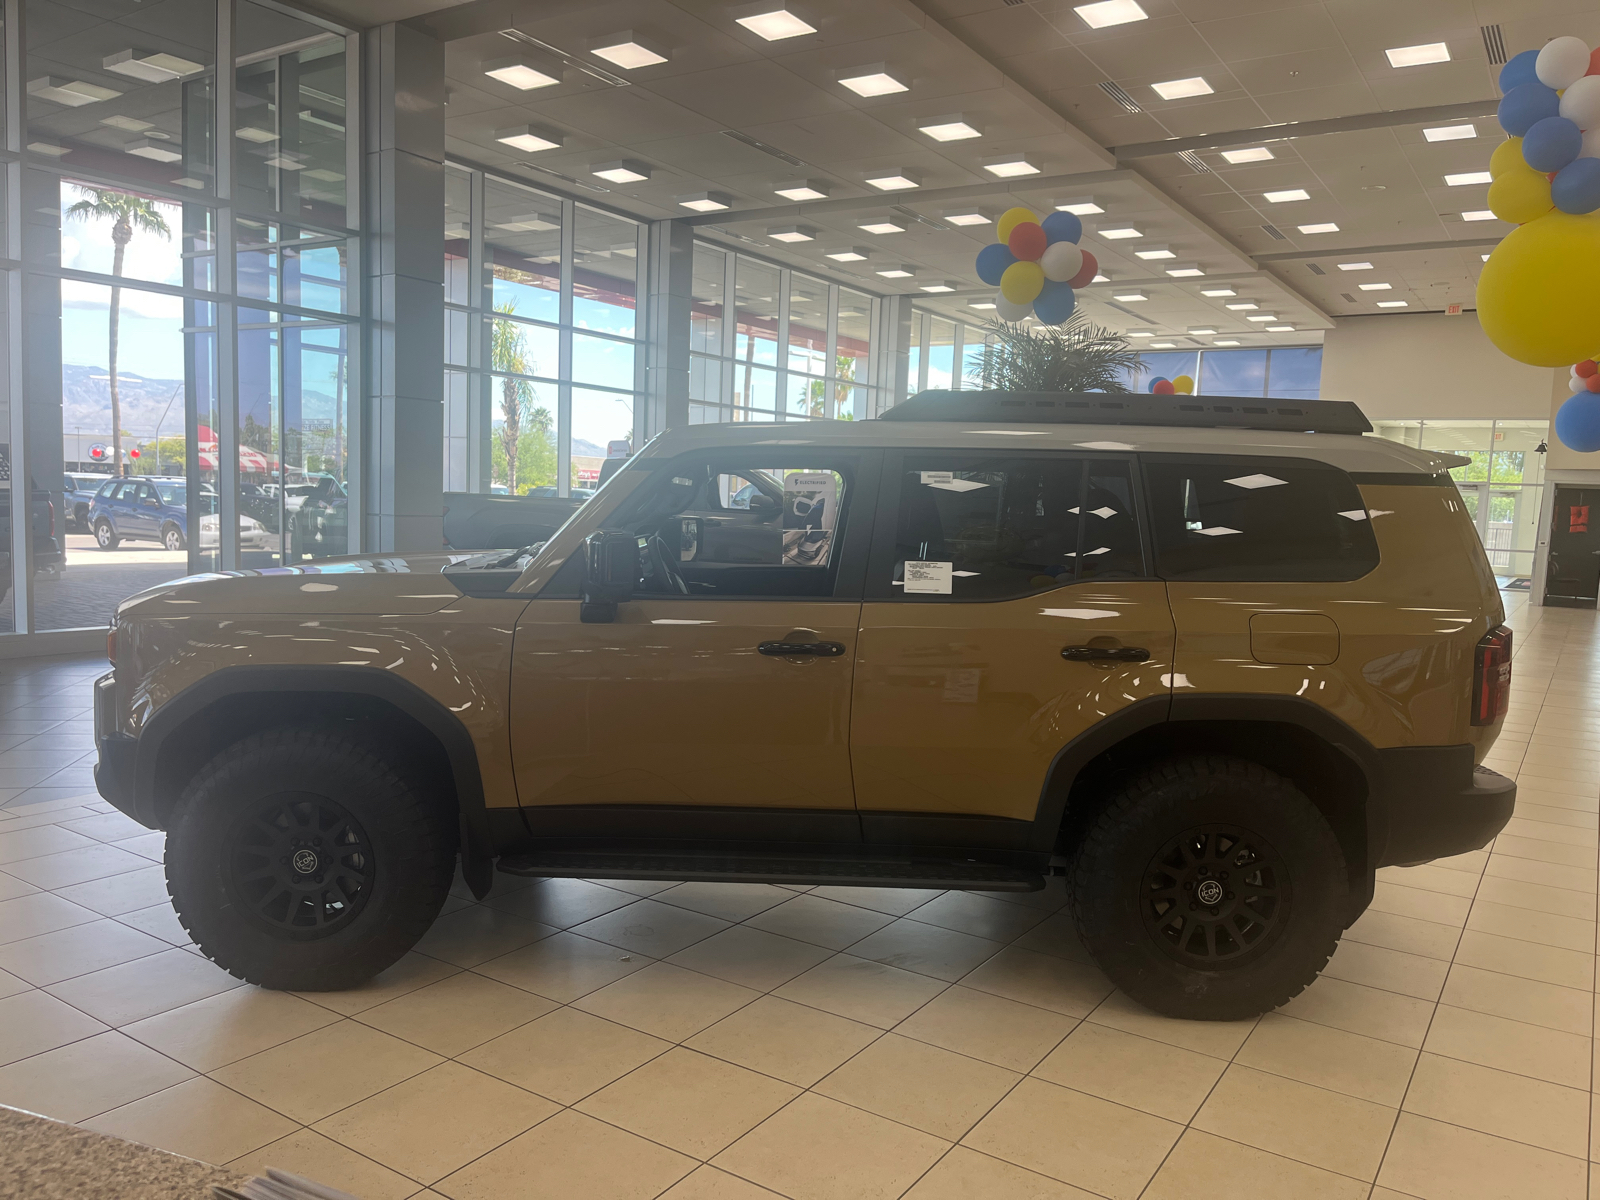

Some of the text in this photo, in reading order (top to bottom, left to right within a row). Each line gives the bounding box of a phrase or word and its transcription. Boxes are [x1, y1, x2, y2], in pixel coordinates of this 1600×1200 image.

[1448, 305, 1460, 314] EXIT
[296, 854, 314, 868] ICON
[1201, 887, 1219, 898] ICON
